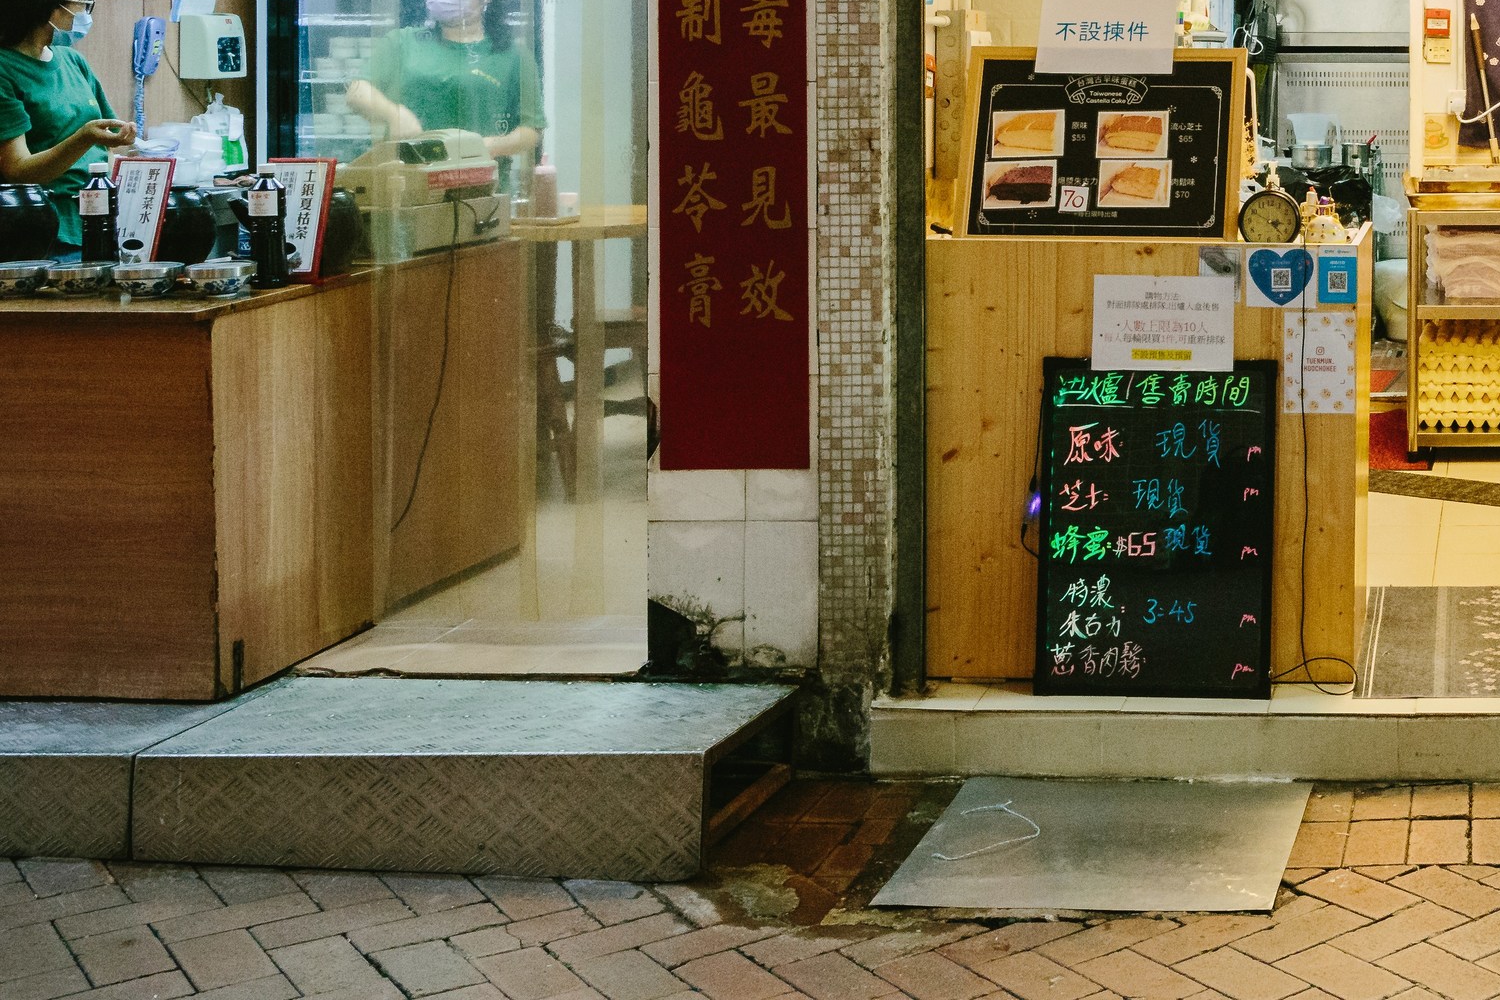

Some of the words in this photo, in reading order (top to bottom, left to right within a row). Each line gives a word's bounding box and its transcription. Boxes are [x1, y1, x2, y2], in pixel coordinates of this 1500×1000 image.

[1055, 21, 1149, 42] 不設揀件
[1071, 121, 1088, 130] 原味
[1071, 133, 1086, 142] $55
[1178, 135, 1193, 143] $65
[1064, 190, 1084, 208] 70
[1175, 190, 1190, 199] $70
[1156, 419, 1222, 469] 現貨
[1248, 445, 1262, 462] pm
[1244, 487, 1260, 501] pm
[1241, 546, 1258, 560] pm
[1143, 599, 1198, 624] 3:45
[1240, 613, 1257, 628] pm
[1231, 663, 1255, 680] pm
